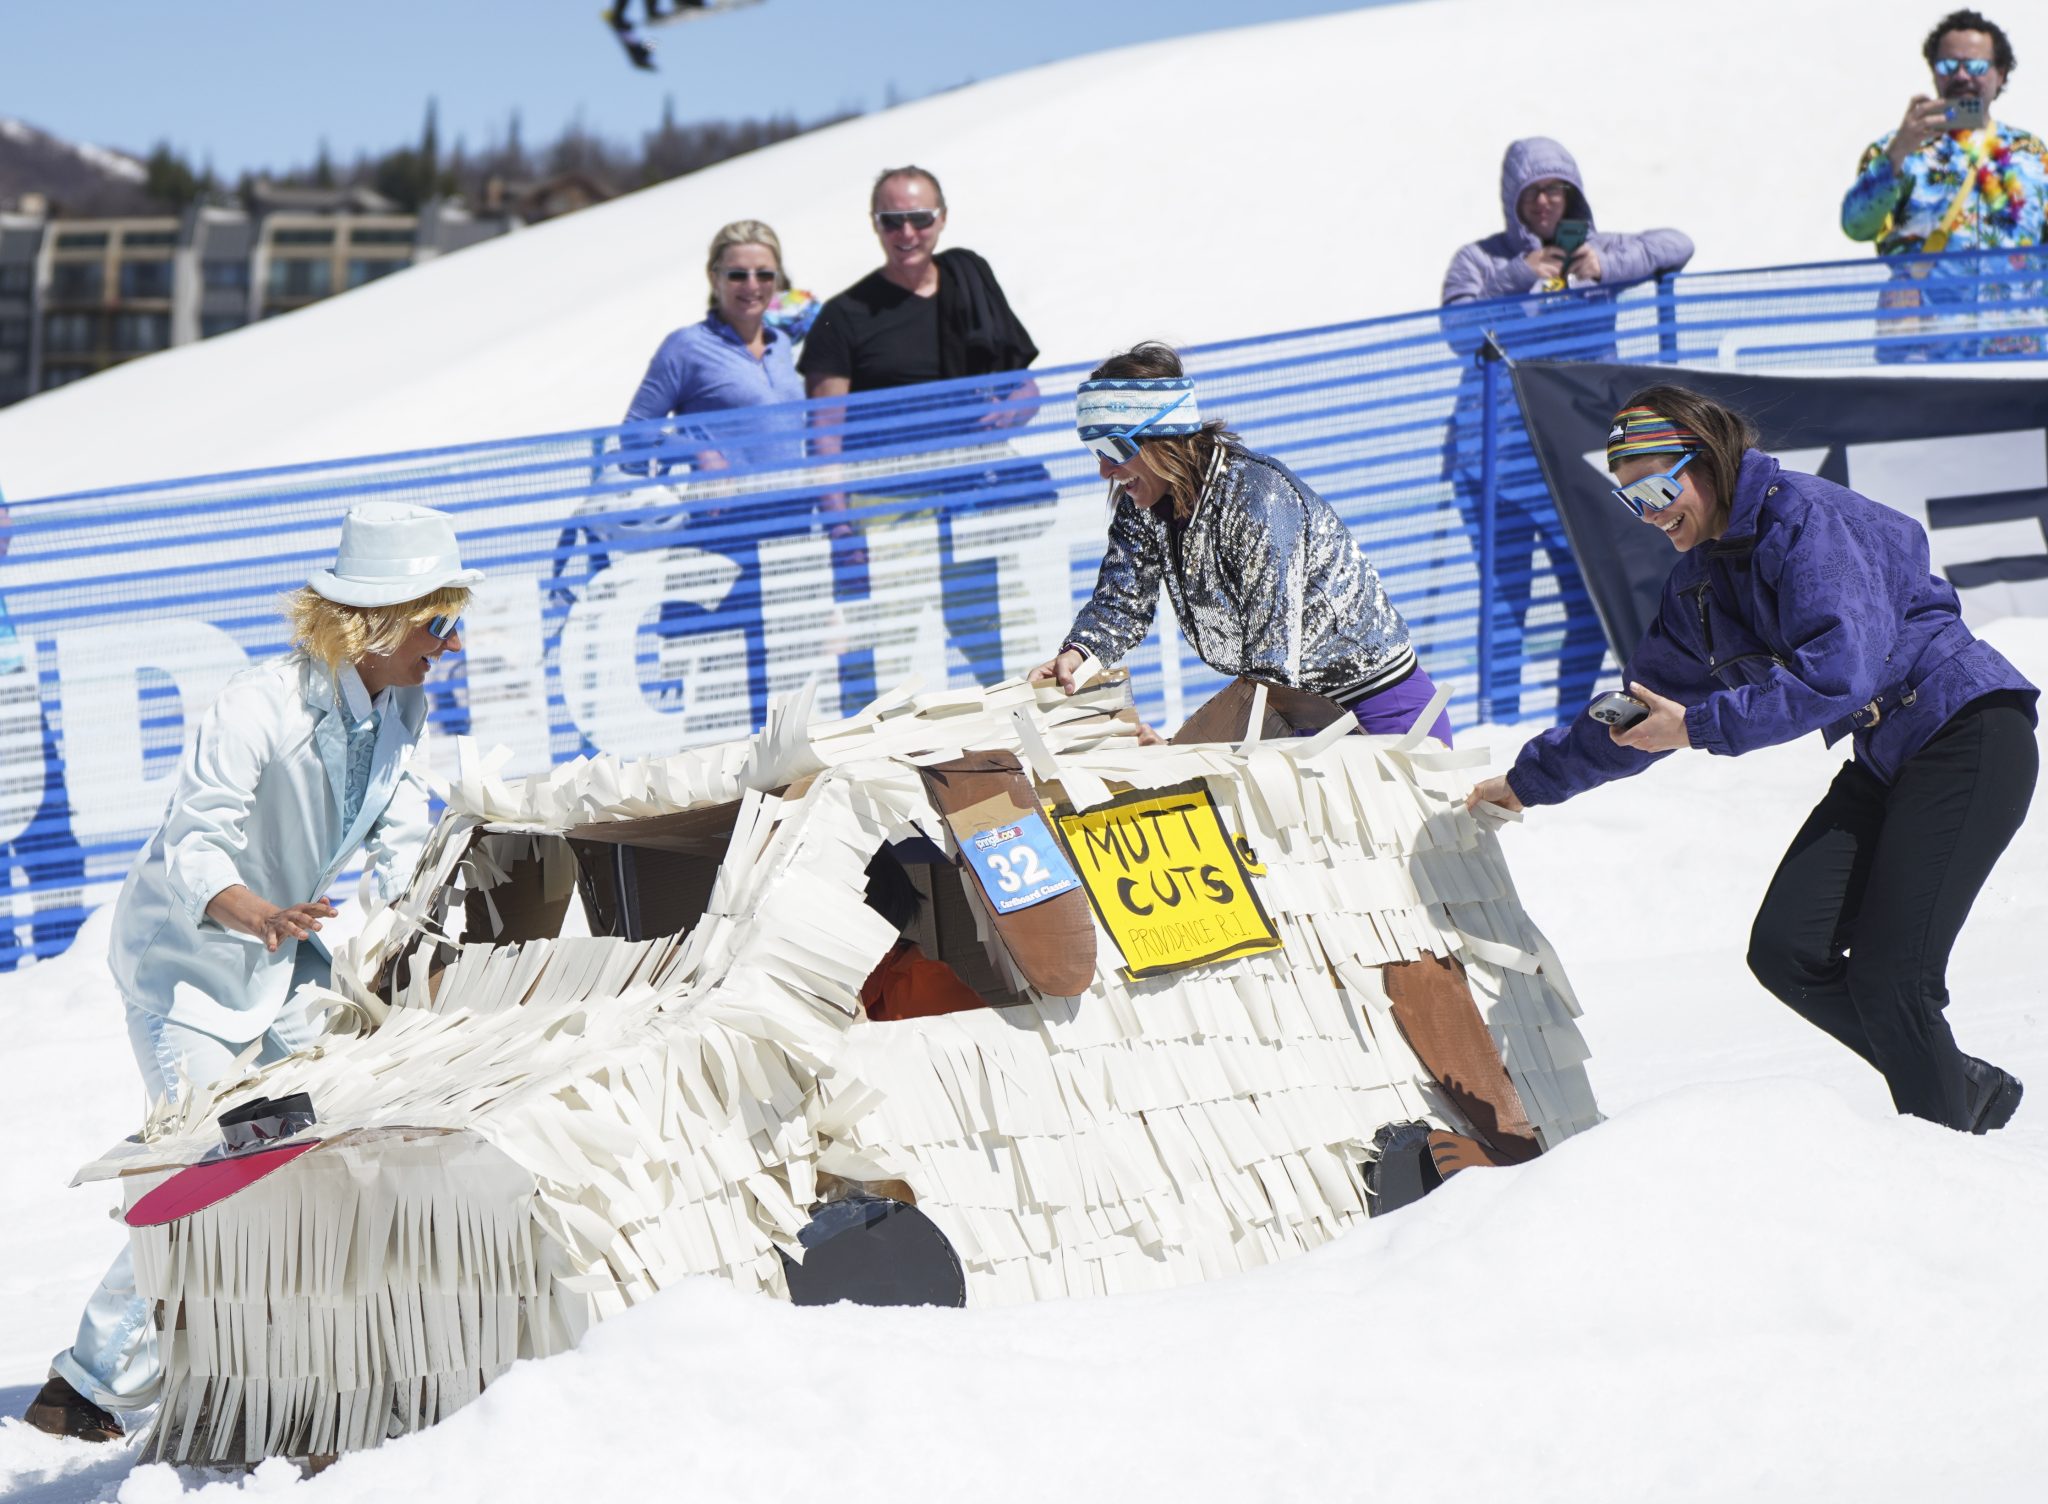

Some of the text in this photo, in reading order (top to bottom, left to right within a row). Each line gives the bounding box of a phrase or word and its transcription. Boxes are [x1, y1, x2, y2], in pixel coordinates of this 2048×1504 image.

[425, 488, 1112, 784] IGHT
[1082, 804, 1201, 872] MUTT
[987, 845, 1050, 893] 32
[1000, 879, 1072, 909] Cardboard Classic
[1116, 864, 1234, 916] CUTS
[1128, 918, 1215, 961] PROVIDENCE
